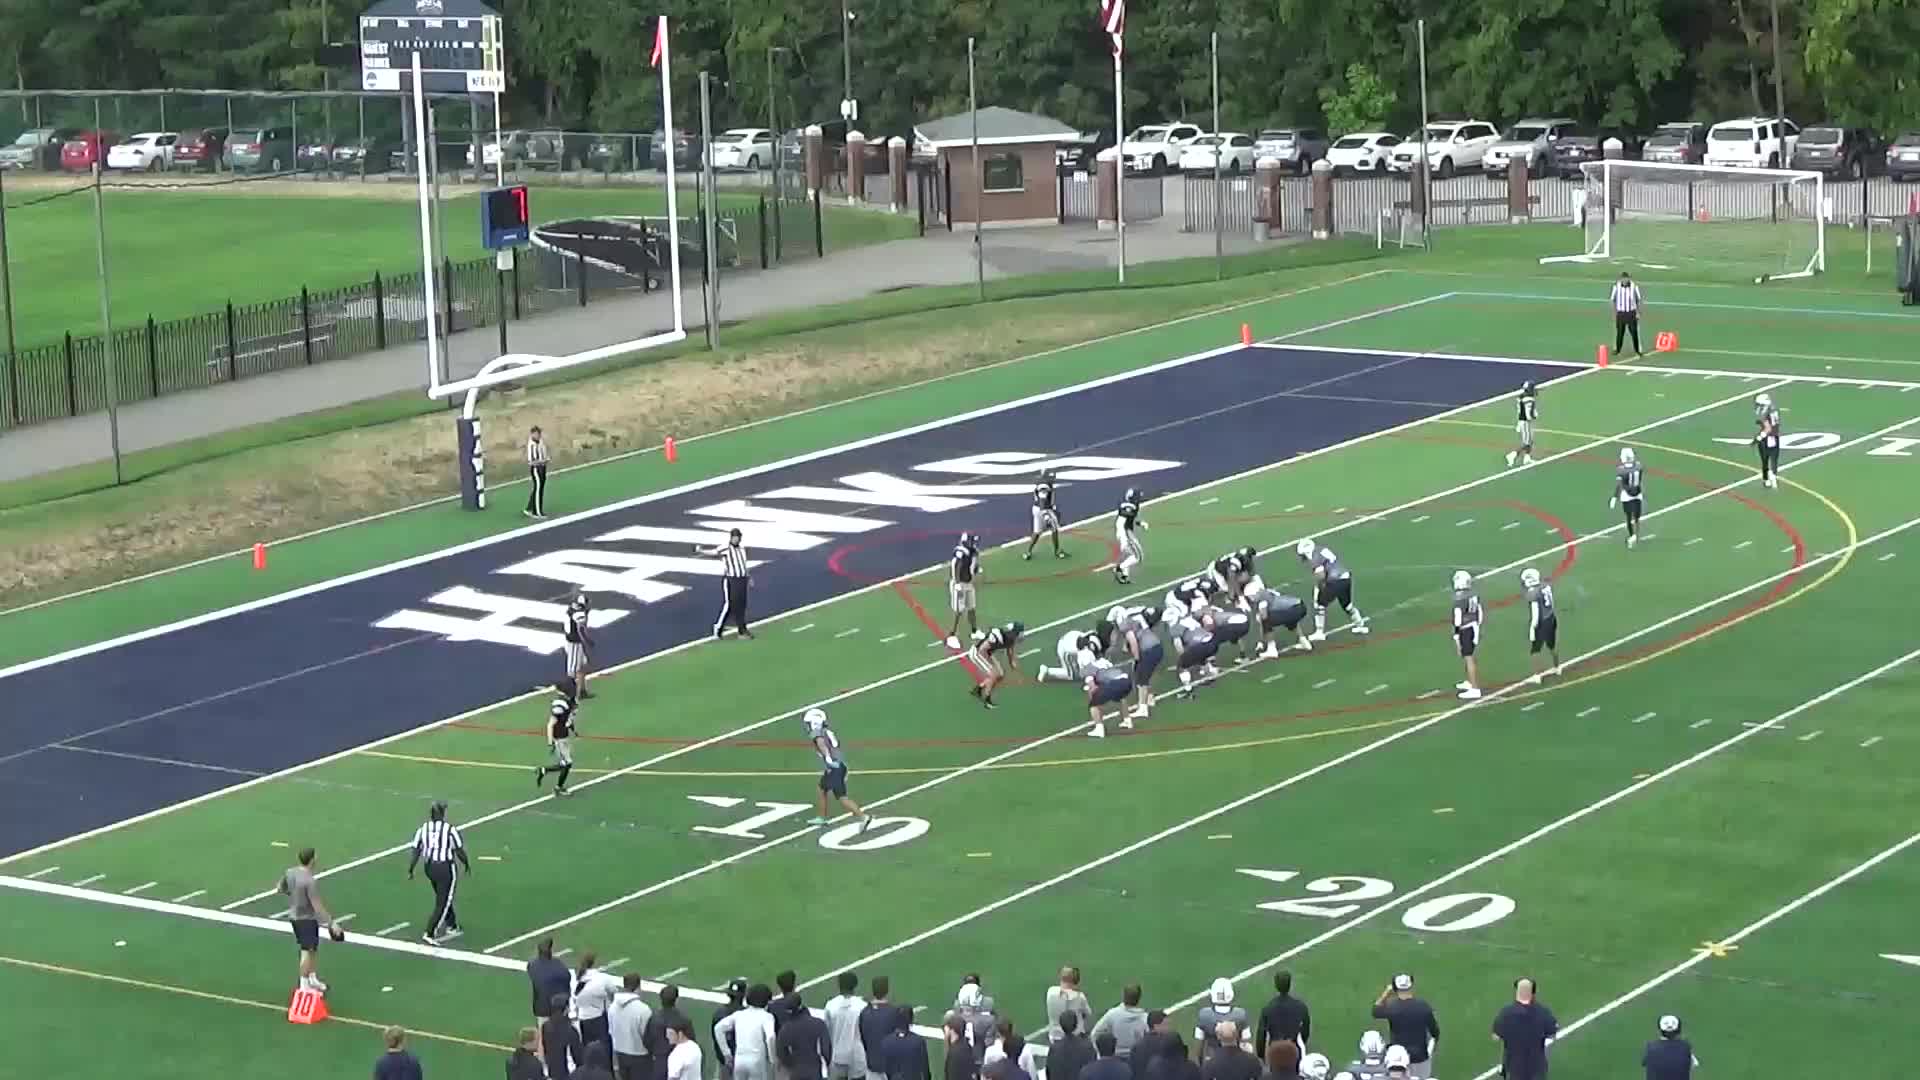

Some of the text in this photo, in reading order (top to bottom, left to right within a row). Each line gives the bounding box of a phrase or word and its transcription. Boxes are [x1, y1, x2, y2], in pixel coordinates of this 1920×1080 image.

[370, 452, 1184, 655] HAWKS
[692, 802, 931, 850] 10
[1255, 876, 1516, 932] 20
